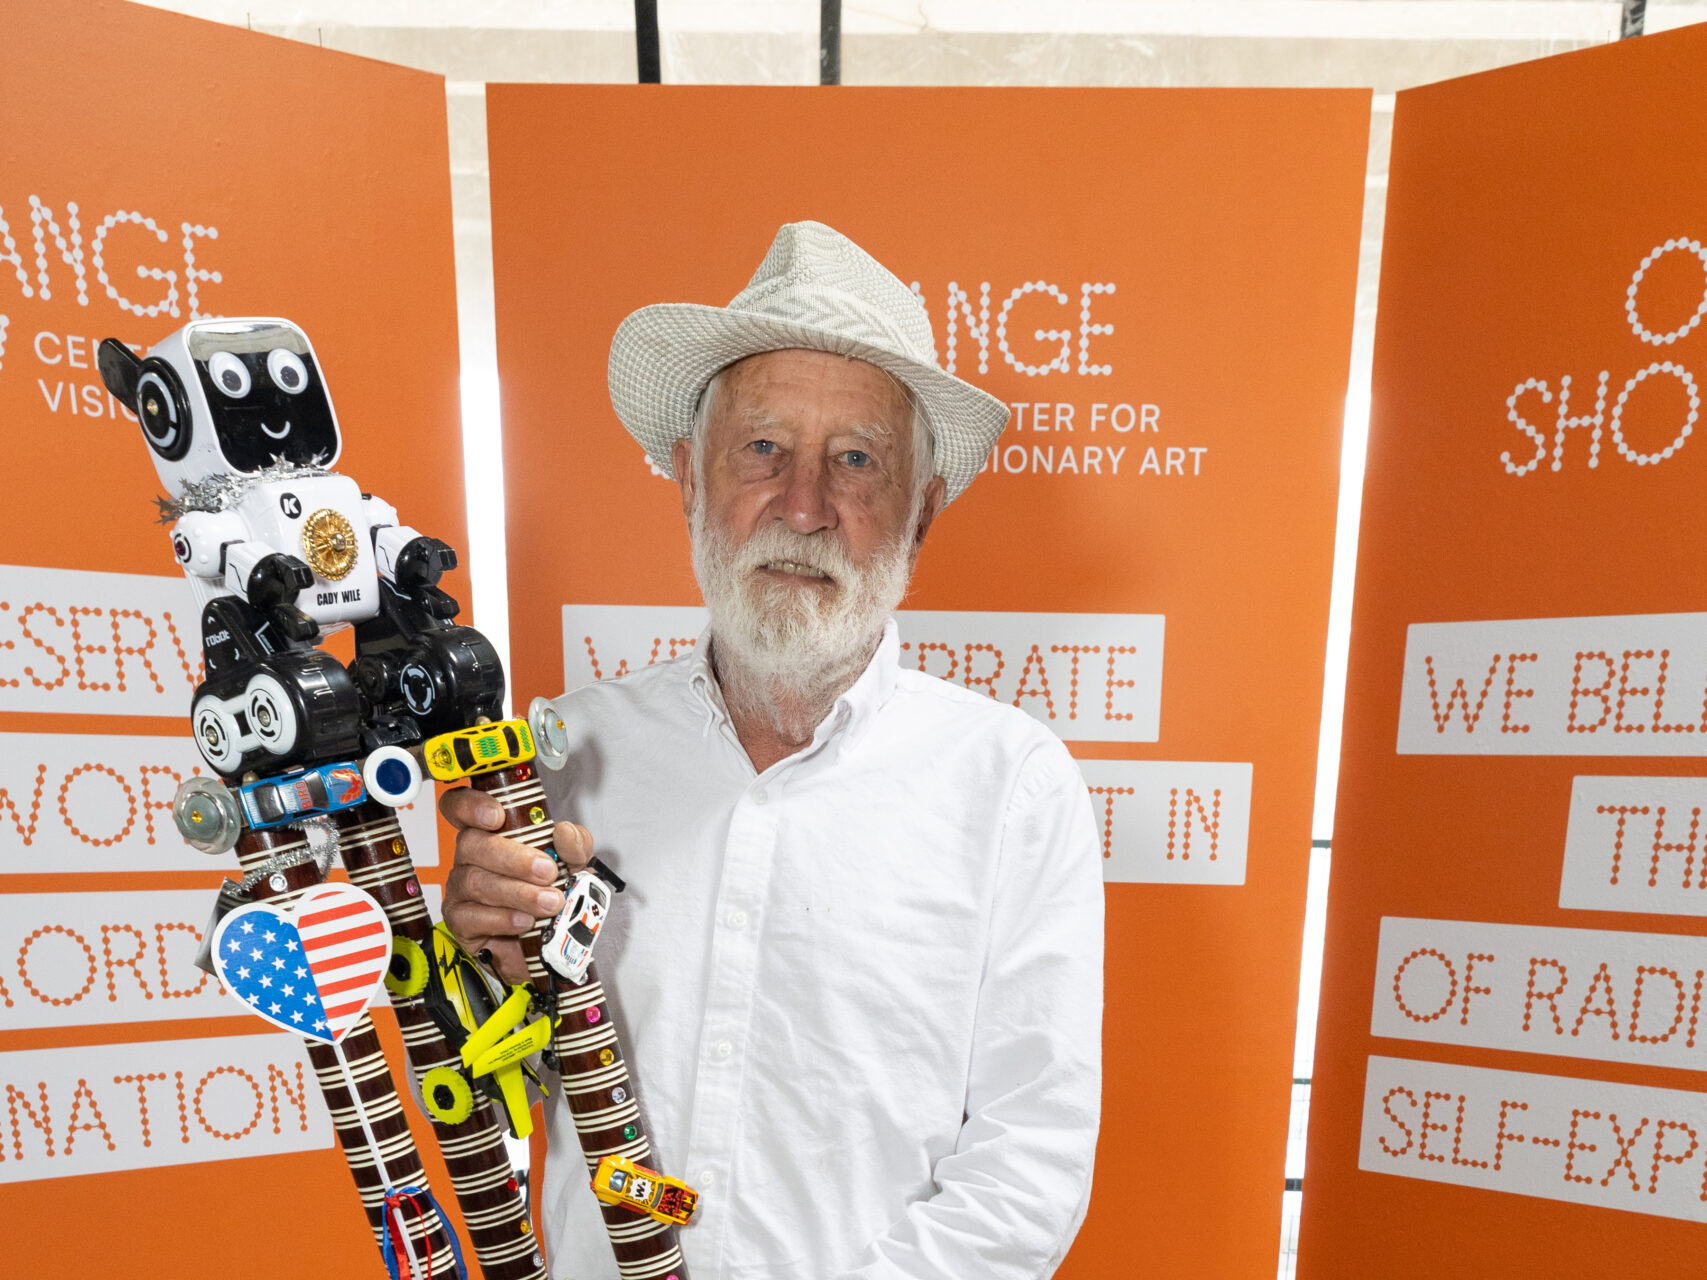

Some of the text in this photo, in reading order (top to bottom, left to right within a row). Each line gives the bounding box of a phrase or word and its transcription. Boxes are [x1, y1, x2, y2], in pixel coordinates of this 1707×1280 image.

[910, 278, 1116, 377] NGE
[1091, 403, 1161, 433] FOR
[980, 445, 1207, 476] IONARY ART
[317, 589, 361, 606] CADY WILE
[1426, 654, 1538, 733] WE
[295, 780, 313, 810] BIRD
[1166, 787, 1221, 862] IN
[0, 923, 227, 1008] ORD
[1395, 948, 1495, 1025] OF
[0, 1062, 309, 1163] NATION
[1378, 1085, 1707, 1202] SELF-EXP
